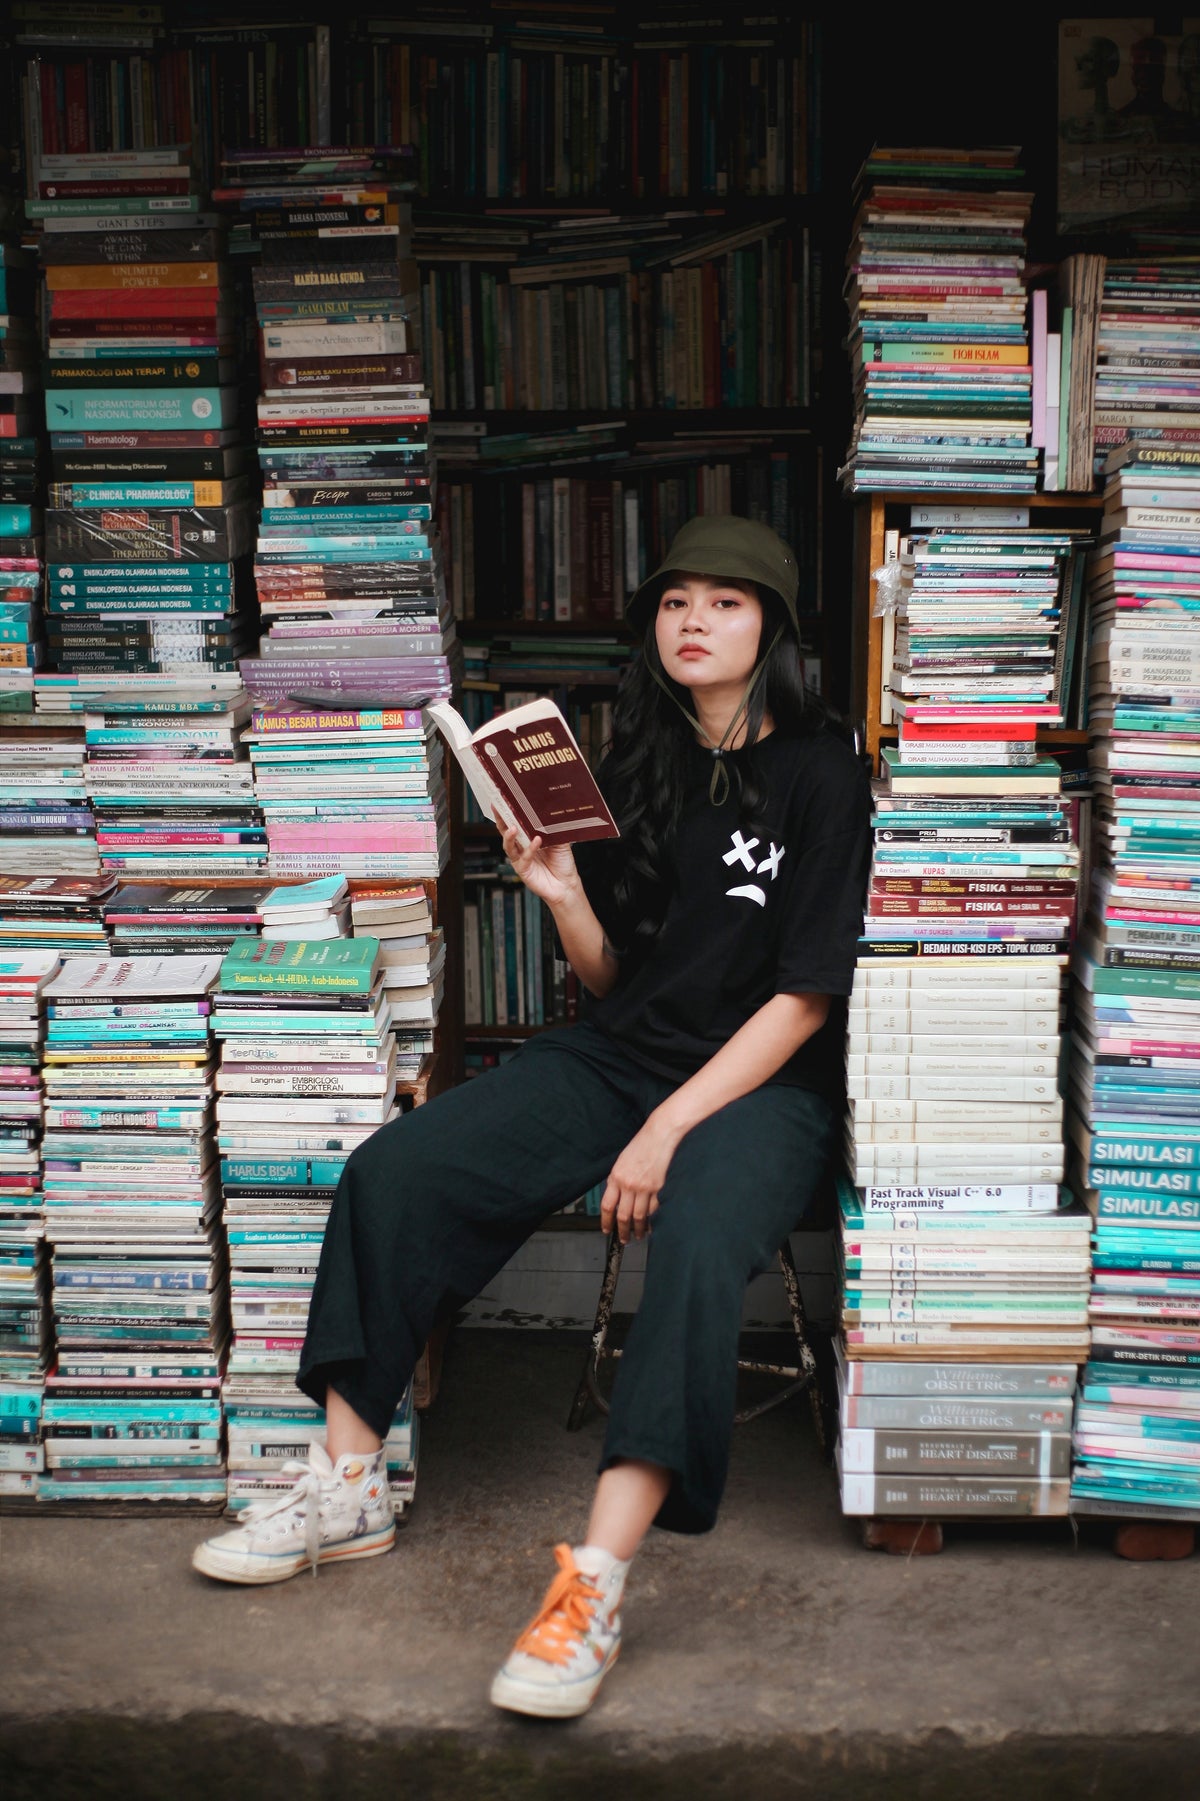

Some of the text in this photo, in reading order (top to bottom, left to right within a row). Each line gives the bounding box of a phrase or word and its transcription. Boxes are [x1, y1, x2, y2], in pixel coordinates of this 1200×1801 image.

[289, 212, 349, 222] BAHASA INDONESIA
[97, 218, 165, 229] GIANT STEPS
[119, 244, 147, 252] GIANT
[107, 253, 141, 261] WITHIN
[113, 266, 168, 276] UNLIMITED
[122, 278, 159, 287] POWER
[320, 274, 339, 284] BASA
[340, 272, 365, 283] SUNDA
[298, 302, 349, 313] AGAMA ISLAM
[974, 350, 999, 361] ISLAM
[51, 367, 166, 378] FARMAKOLOGI DAN TERAPI
[85, 400, 181, 409] INFORMATORIUM OBAT
[85, 409, 182, 419] NASIONAL INDONESIA
[310, 405, 341, 415] berpikir
[1099, 415, 1135, 424] MARGA T
[1097, 427, 1128, 436] SCOTT
[88, 435, 138, 446] Haematology
[1095, 436, 1130, 444] TUROW
[106, 463, 132, 471] Nursing
[133, 463, 167, 471] Dictionary
[89, 489, 191, 500] CLINICAL PHARMACOLOGY
[312, 491, 350, 504] Escape
[311, 512, 353, 520] KECAMATAN
[1137, 514, 1190, 524] PENELITIAN
[151, 522, 167, 531] THE
[1136, 532, 1178, 541] Recruitment
[59, 567, 74, 578] 3
[157, 568, 189, 576] INDONESIA
[61, 585, 193, 595] 2 ENSIKLOPEDIA OLAHRAGA INDONESIA
[60, 602, 75, 610] 1
[86, 601, 126, 609] ENSIKLOPEDIA
[128, 601, 158, 609] OLAHRAGA
[1143, 647, 1192, 656] MANAJEMEN
[1142, 653, 1191, 662] PERSONALIA
[1143, 668, 1192, 676] MANAJEMEN
[1142, 673, 1191, 682] PERSONALIA
[145, 703, 176, 711] KAMUS
[180, 703, 199, 711] MBA
[256, 713, 403, 730] KAMUS BESAR BAHASA INDONESIA
[513, 732, 555, 753] KAMUS
[513, 748, 577, 773] PSYCHOLOGI
[923, 867, 993, 875] KUPAS MATEMATIKA
[969, 883, 1006, 893] FISIKA
[966, 902, 1003, 912] FISIKA
[1128, 930, 1176, 941] PENGANTAR
[924, 944, 1056, 953] BEDAH KISI-KISI EPS-TOPIK KOREA
[1124, 951, 1171, 960] MANAGERIAL
[236, 973, 359, 986] Kamus Arab Arab-Indonesia
[251, 1077, 285, 1086] Langman
[98, 1113, 157, 1126] BAHASA INDONESIA
[1094, 1143, 1192, 1163] SIMULASI
[228, 1165, 297, 1176] HARUS BISA!
[1091, 1169, 1190, 1190] SIMULASI
[871, 1188, 893, 1198] Fast
[896, 1188, 924, 1197] Track
[928, 1187, 960, 1197] Visual
[986, 1187, 1001, 1197] 6.0
[871, 1199, 944, 1210] Programming
[1103, 1197, 1199, 1217] SIMULASI
[268, 1233, 299, 1241] Kebidanan
[1114, 1351, 1187, 1363] DETIK-DETIK FOKUS
[935, 1370, 1002, 1380] Williams
[925, 1380, 1018, 1391] OBSTETRICS
[929, 1405, 998, 1416] Williams
[920, 1415, 1013, 1426] OBSTETRICS
[266, 1446, 294, 1457] PENYAKIT
[920, 1450, 1017, 1460] HEART DISEASE
[920, 1493, 1017, 1503] HEART DISEASE
